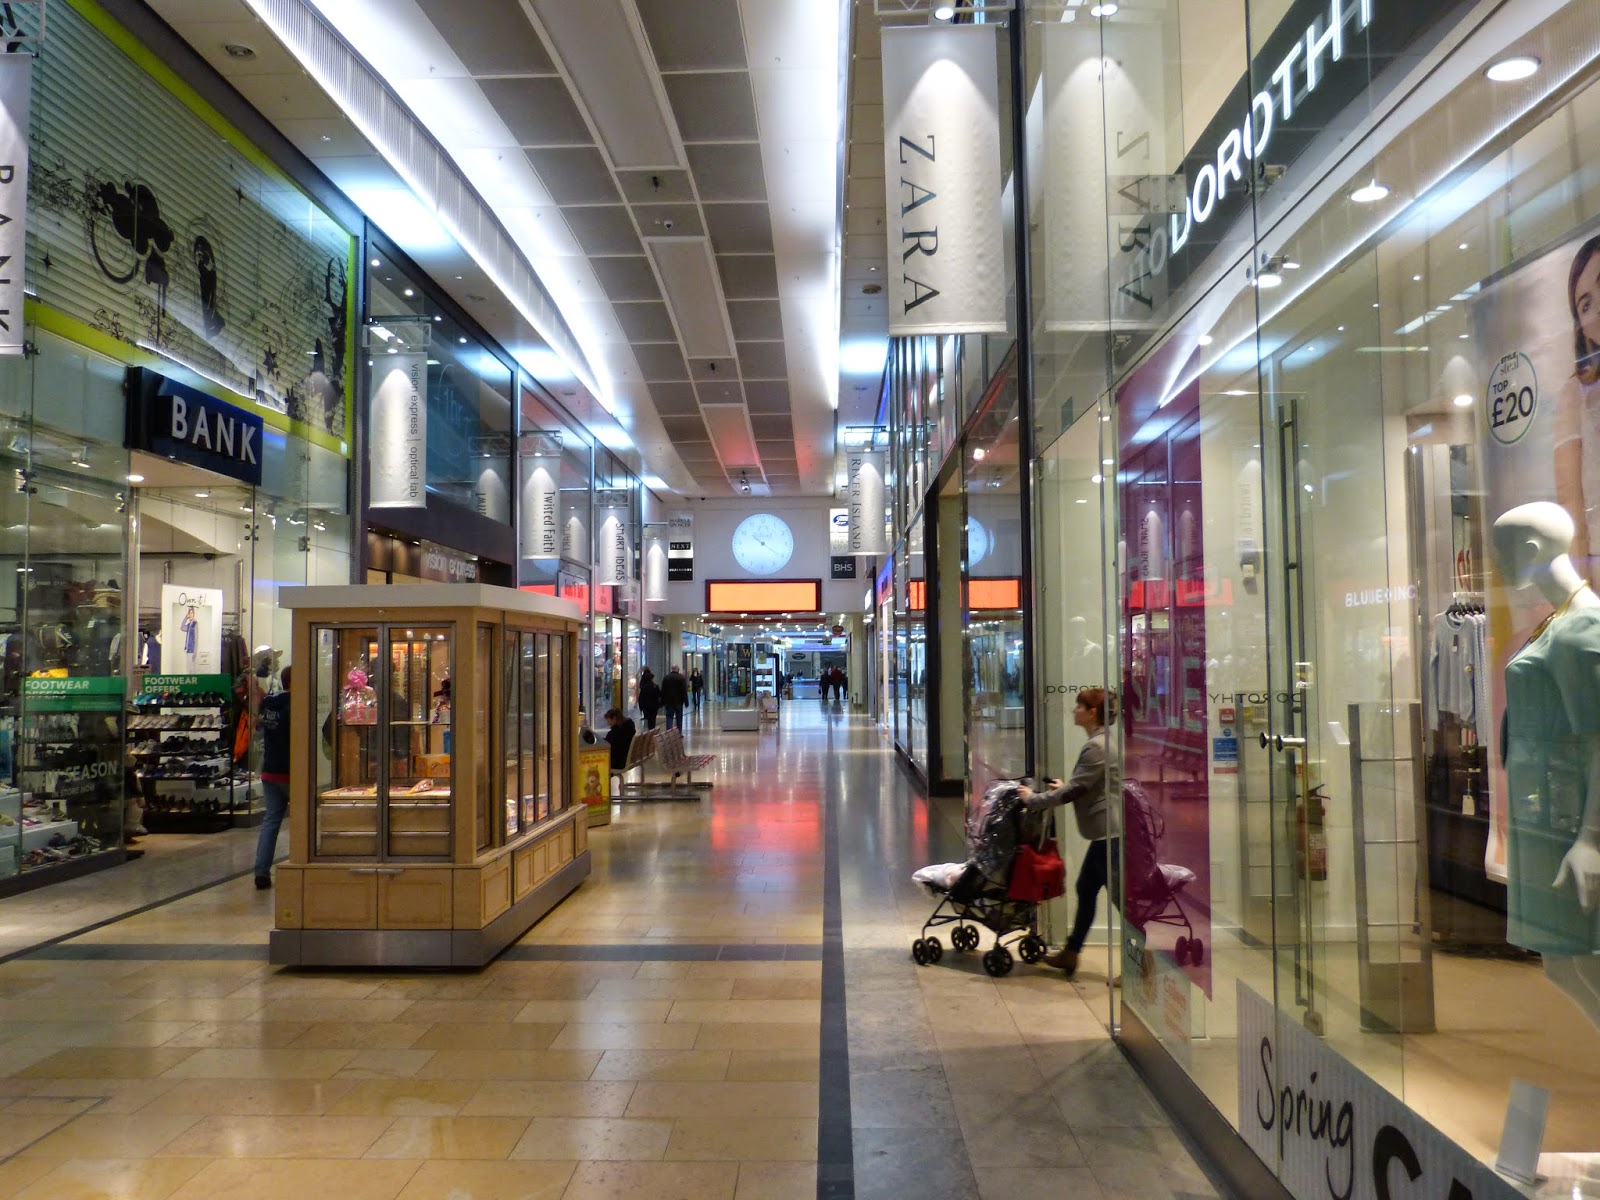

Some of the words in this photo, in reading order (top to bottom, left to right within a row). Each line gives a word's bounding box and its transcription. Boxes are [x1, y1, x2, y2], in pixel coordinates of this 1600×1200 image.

[1171, 0, 1371, 255] DOROTH
[899, 134, 941, 316] ZARA
[411, 363, 420, 393] vision
[1492, 380, 1509, 395] TOP
[409, 395, 419, 435] express
[1491, 386, 1534, 429] £20
[171, 394, 257, 465] BANK
[408, 446, 420, 480] optical
[851, 458, 862, 497] RIVER
[409, 482, 419, 498] lab
[543, 491, 556, 526] Twisted
[543, 529, 556, 553] Faith
[615, 523, 625, 551] SMART
[851, 503, 862, 550] ISLAND
[615, 555, 626, 581] IDEAS
[833, 563, 853, 572] BHS
[25, 680, 90, 691] FOOTWEAR
[144, 676, 198, 685] FOOTWEAR
[145, 685, 181, 694] OFFERS
[1046, 685, 1118, 694] DOROY
[64, 761, 118, 783] SEASON
[1256, 1036, 1354, 1200] Spring
